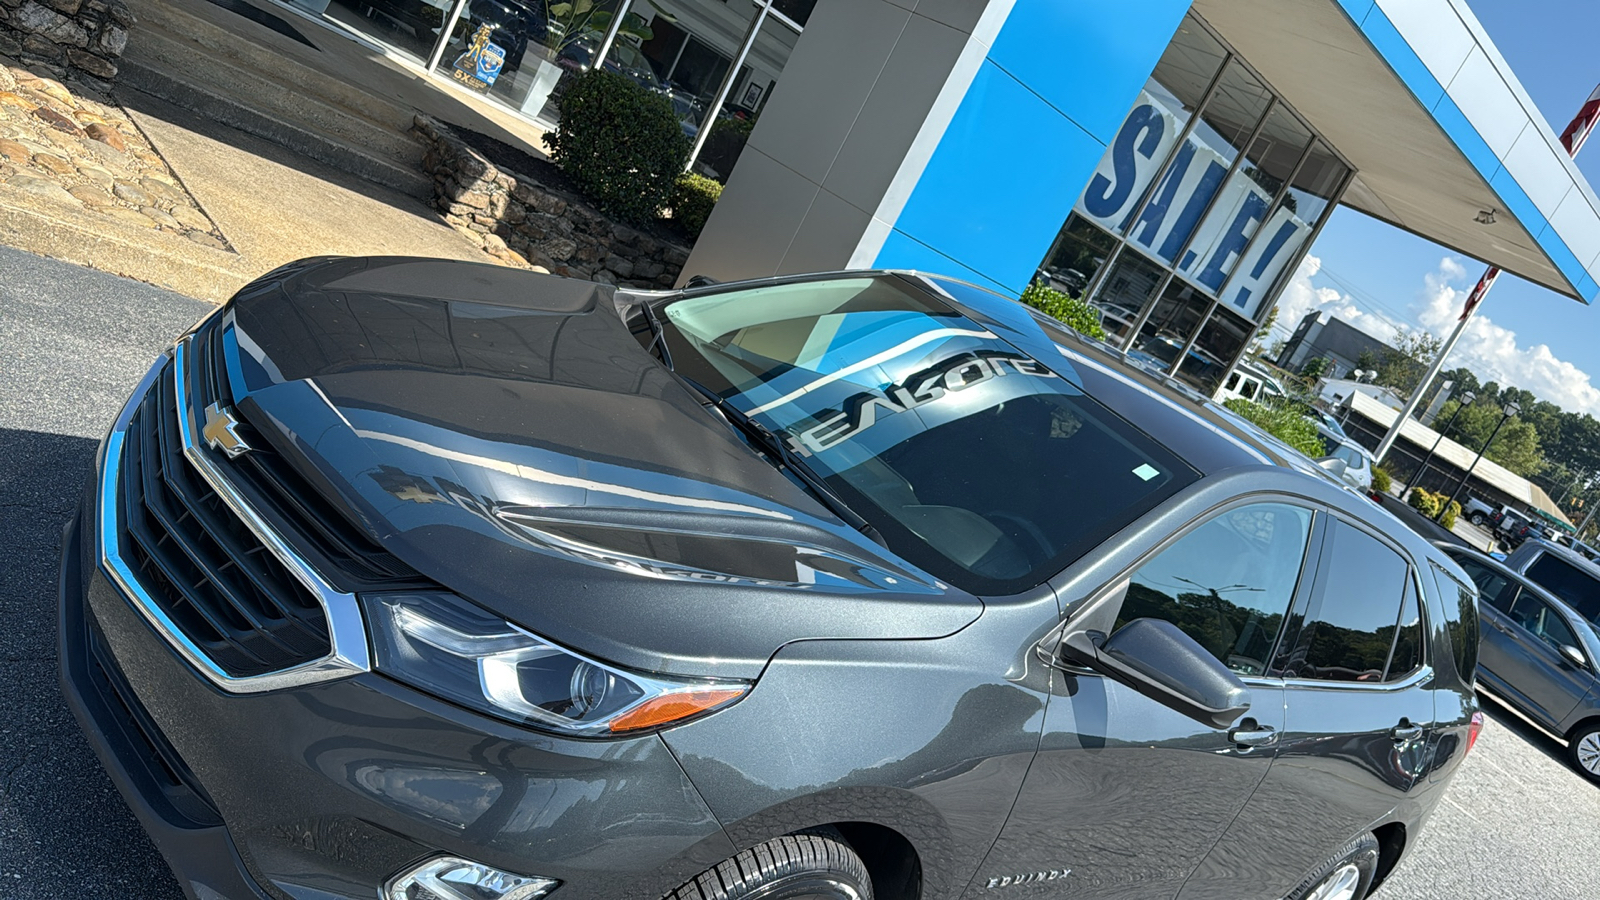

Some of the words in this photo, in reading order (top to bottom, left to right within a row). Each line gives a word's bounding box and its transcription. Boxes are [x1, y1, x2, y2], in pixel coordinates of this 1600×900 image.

[454, 69, 471, 83] 5X
[1084, 104, 1300, 309] SALE!
[985, 868, 1072, 889] EQUINOX
